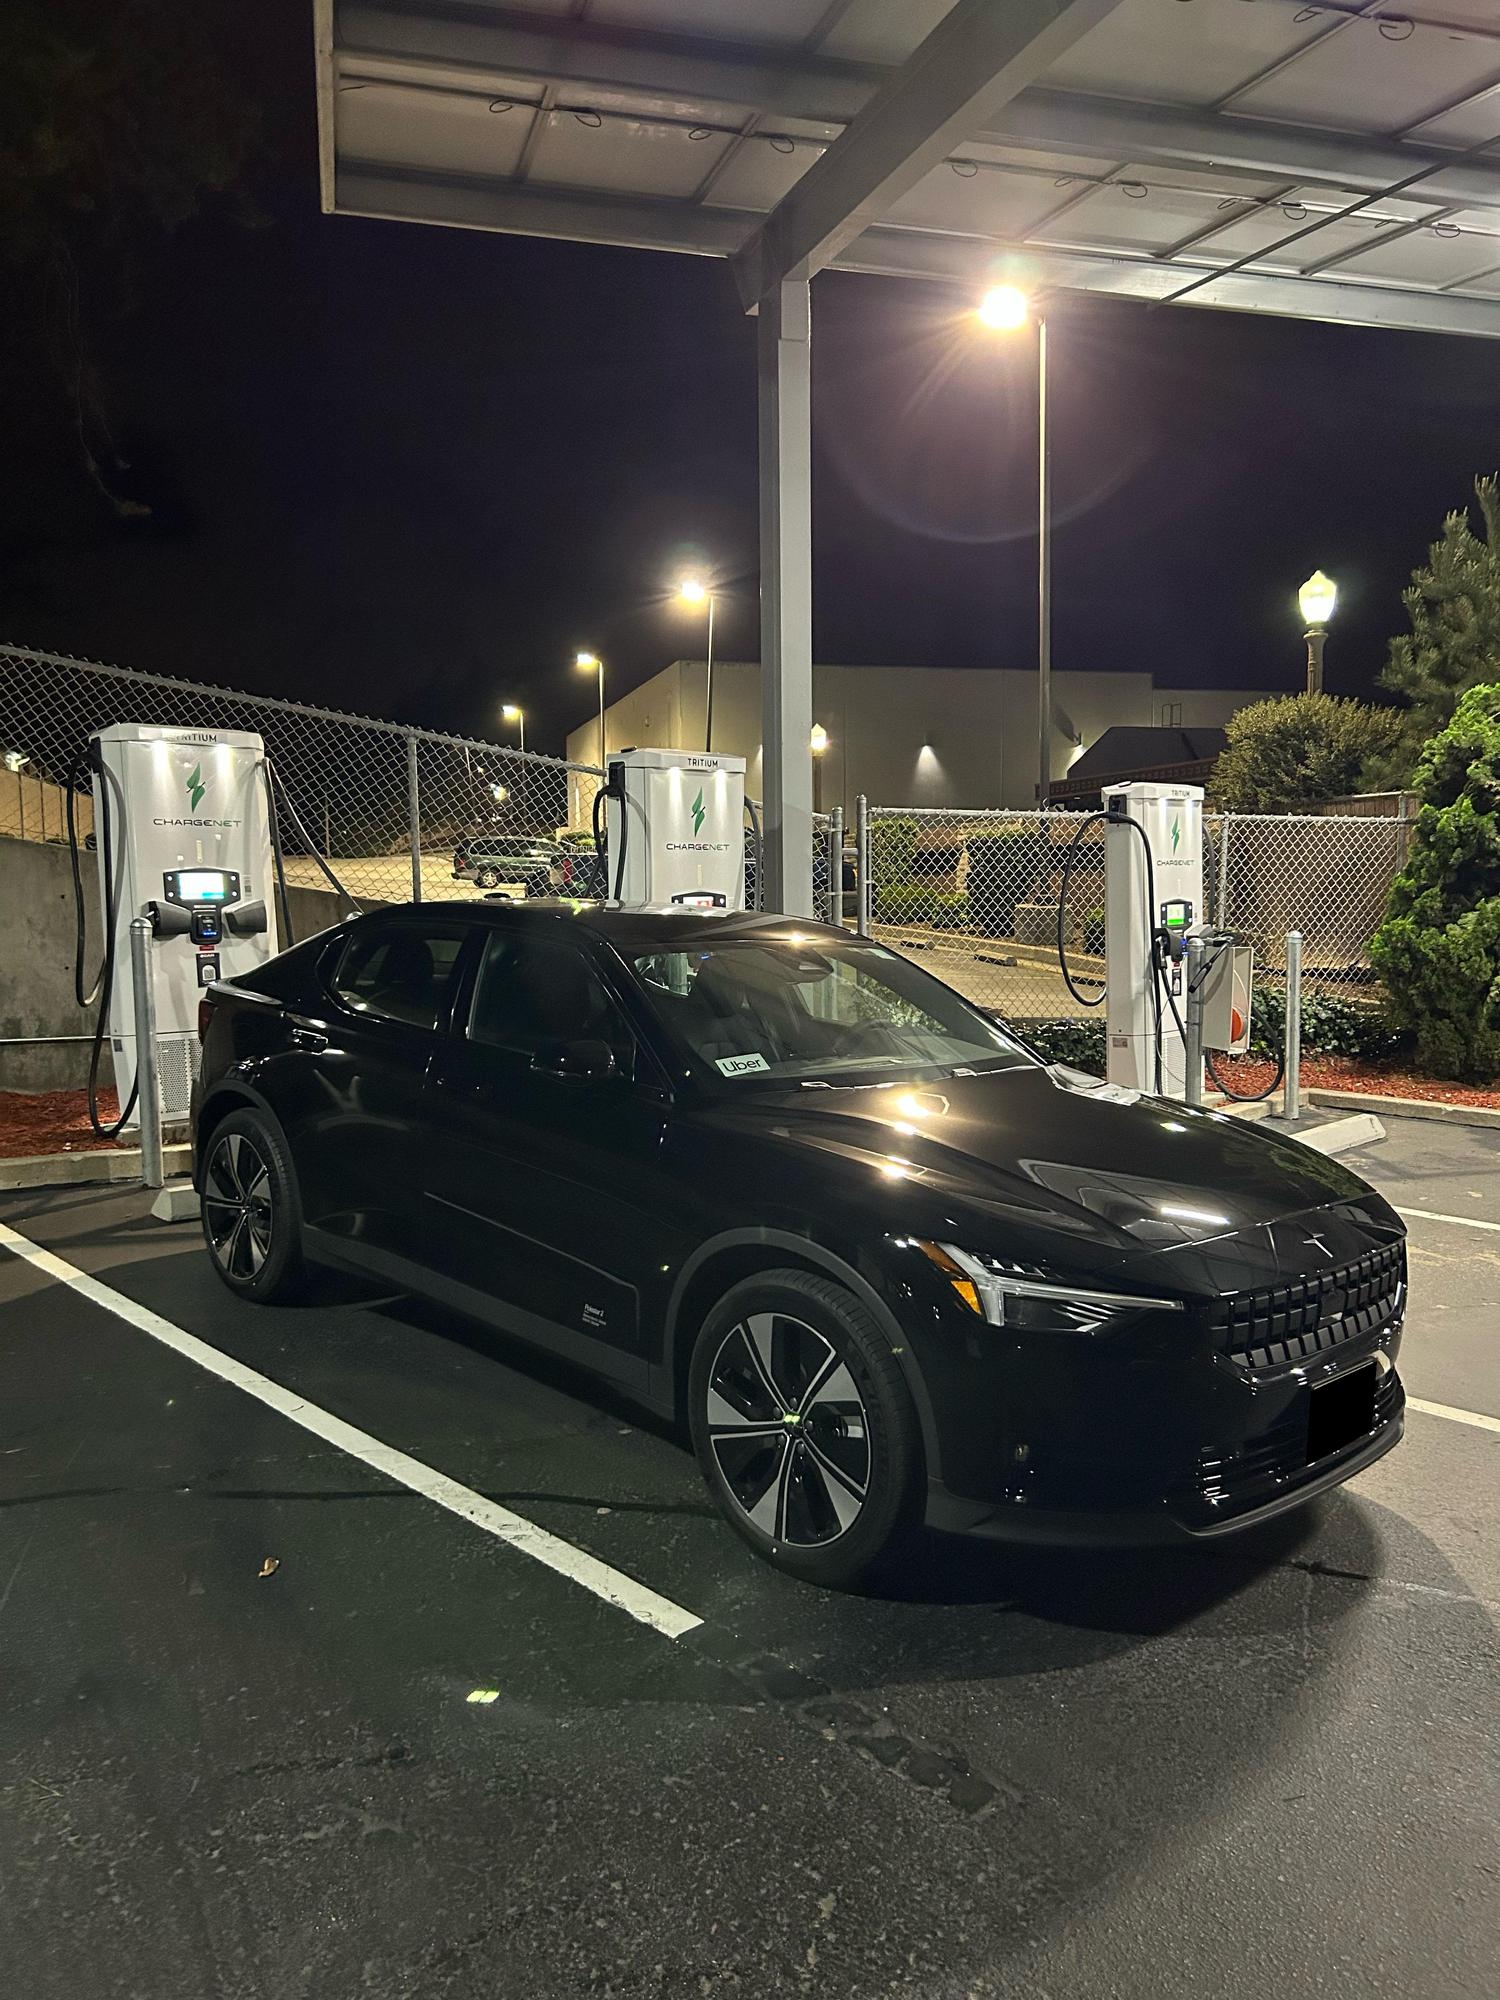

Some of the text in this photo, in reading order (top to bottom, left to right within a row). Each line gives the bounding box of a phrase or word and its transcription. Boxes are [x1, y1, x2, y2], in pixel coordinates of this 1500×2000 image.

[688, 758, 719, 767] TRITIUM
[153, 818, 242, 828] CHARGENET
[666, 843, 730, 851] CHARGENET
[722, 1059, 761, 1072] Uber
